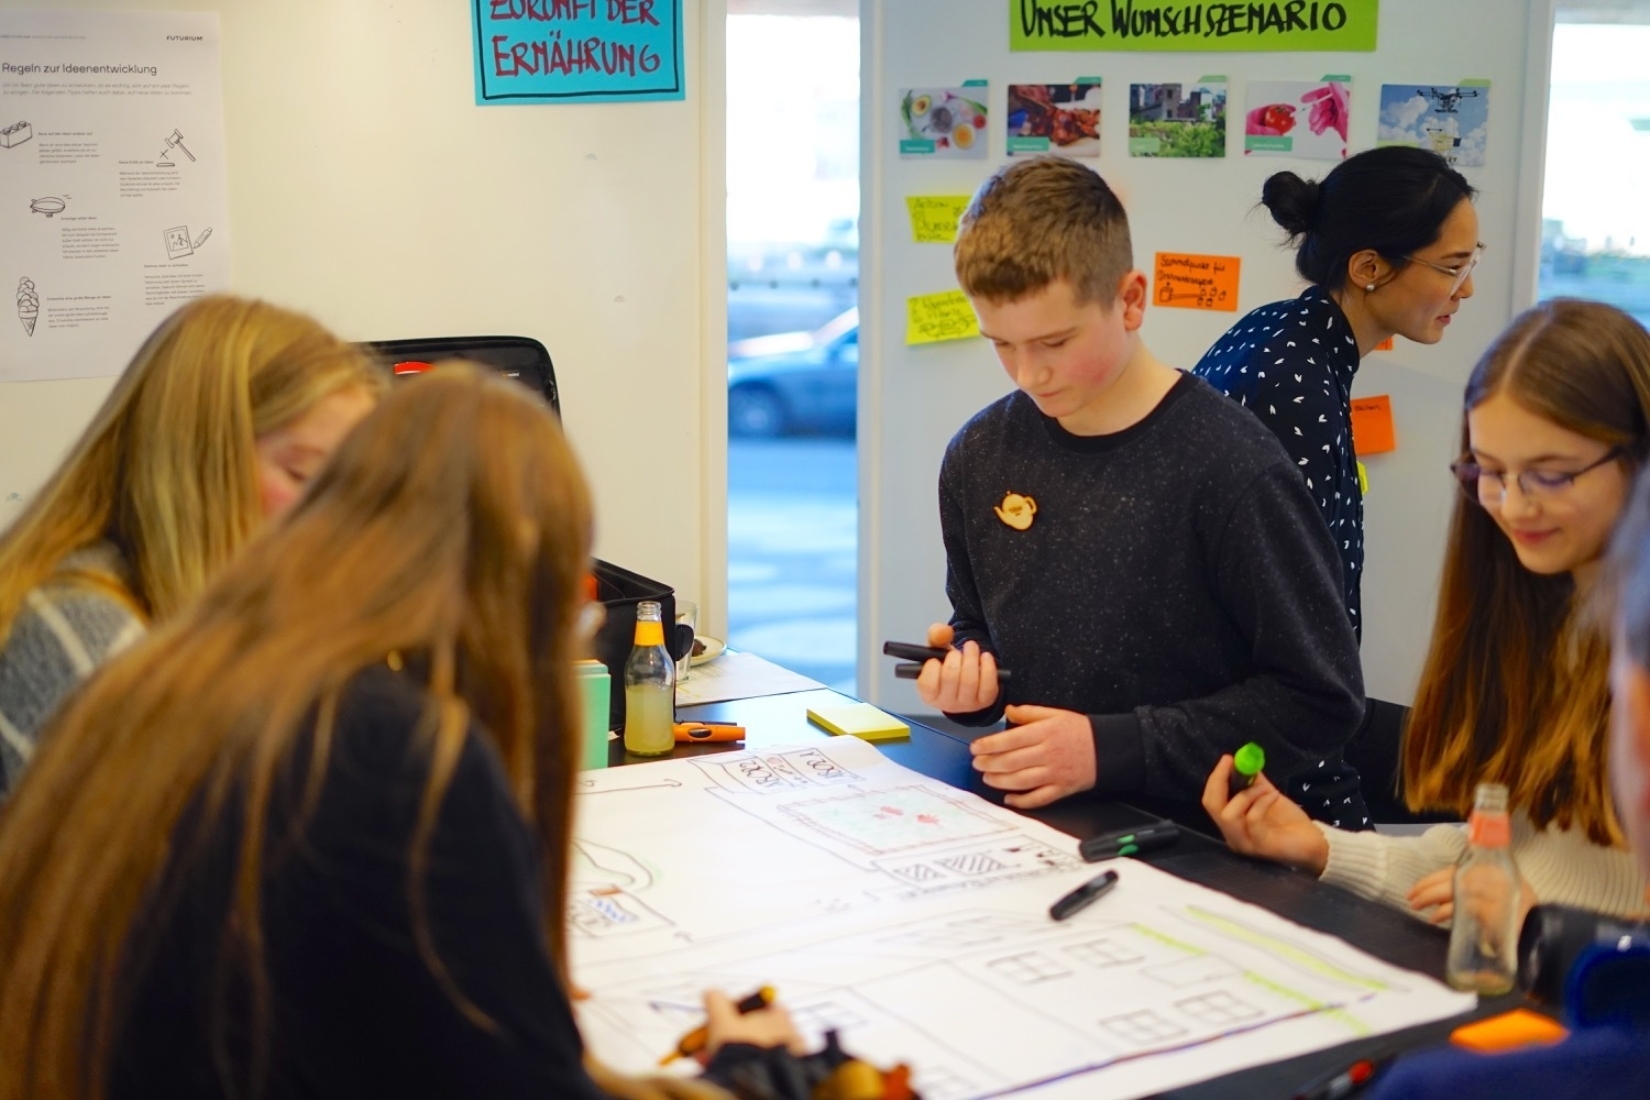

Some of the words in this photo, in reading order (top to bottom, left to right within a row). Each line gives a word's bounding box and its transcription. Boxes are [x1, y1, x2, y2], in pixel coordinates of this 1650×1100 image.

[607, 0, 660, 26] DER
[1021, 0, 1106, 38] UNSER
[2, 63, 41, 75] Regeln
[43, 65, 60, 73] zur
[62, 64, 157, 76] Ideenentwicklung
[492, 30, 660, 77] ERNÄHRUNG
